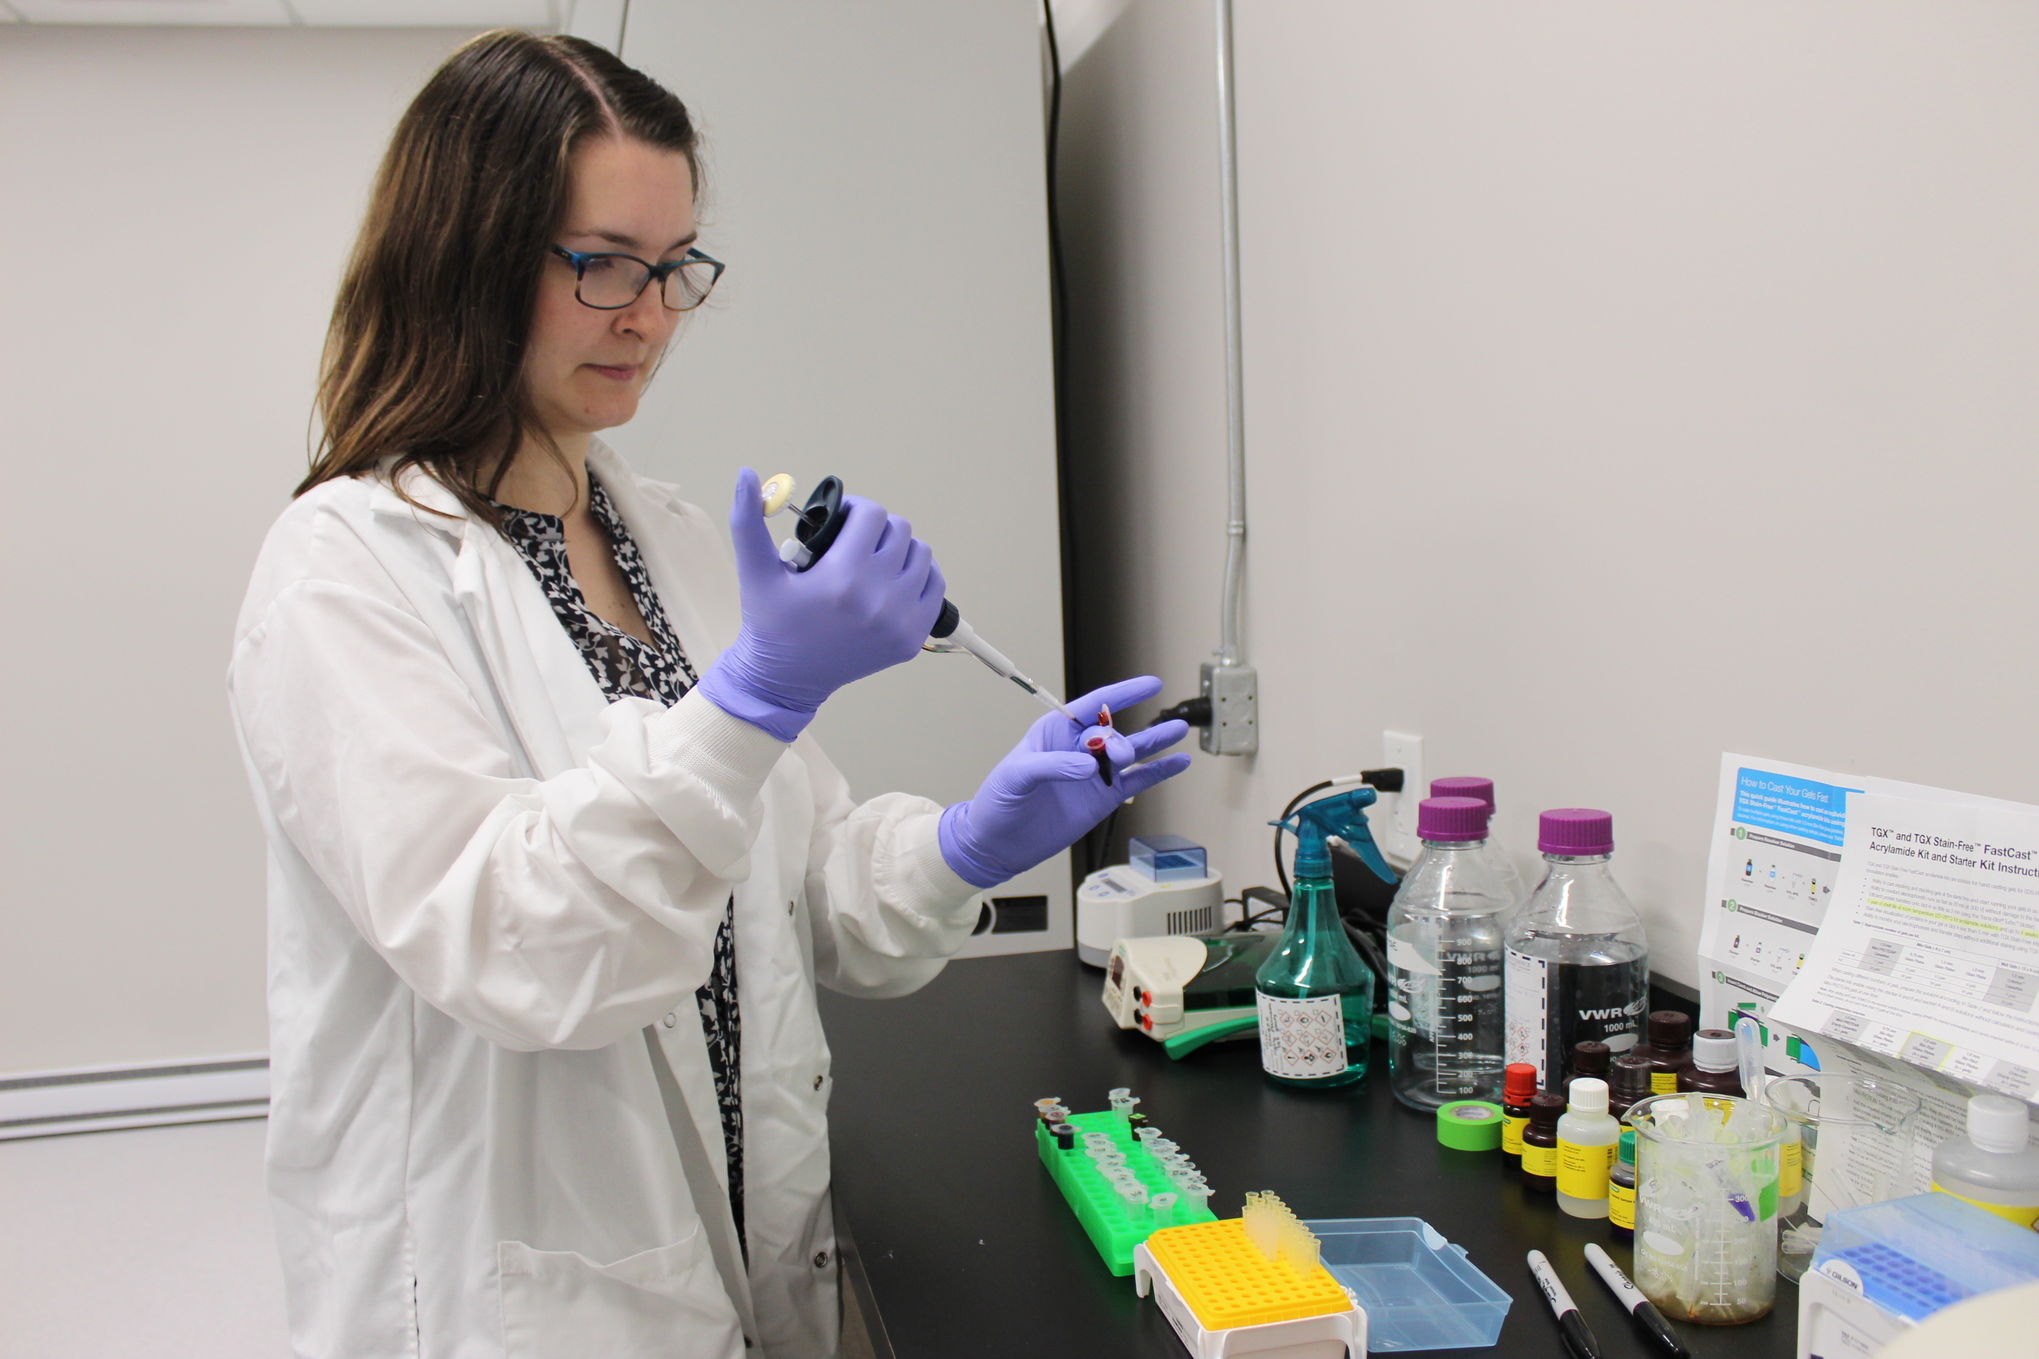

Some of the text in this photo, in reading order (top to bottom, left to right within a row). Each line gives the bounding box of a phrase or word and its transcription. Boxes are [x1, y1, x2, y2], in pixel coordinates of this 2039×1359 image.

[1741, 776, 1758, 788] How
[1759, 779, 1766, 790] to
[1767, 781, 1785, 793] Cast
[1785, 784, 1801, 796] Your
[1896, 832, 1912, 842] and
[1914, 833, 1932, 846] TGX
[1869, 841, 1916, 858] Acrylamide
[1917, 848, 1930, 860] Kit
[1931, 852, 1947, 863] and
[1949, 854, 1977, 868] Starter
[1980, 859, 1995, 871] Kit
[1456, 938, 1472, 946] 900
[1457, 957, 1472, 965] 800
[1457, 976, 1472, 984] 700
[1457, 994, 1473, 1003] 600
[1457, 1014, 1473, 1022] 500
[1579, 1007, 1623, 1020] VWR
[1604, 1023, 1624, 1033] 1000
[1458, 1033, 1473, 1041] 400
[1734, 1279, 1747, 1287] 100
[1831, 1271, 1858, 1289] GILSON
